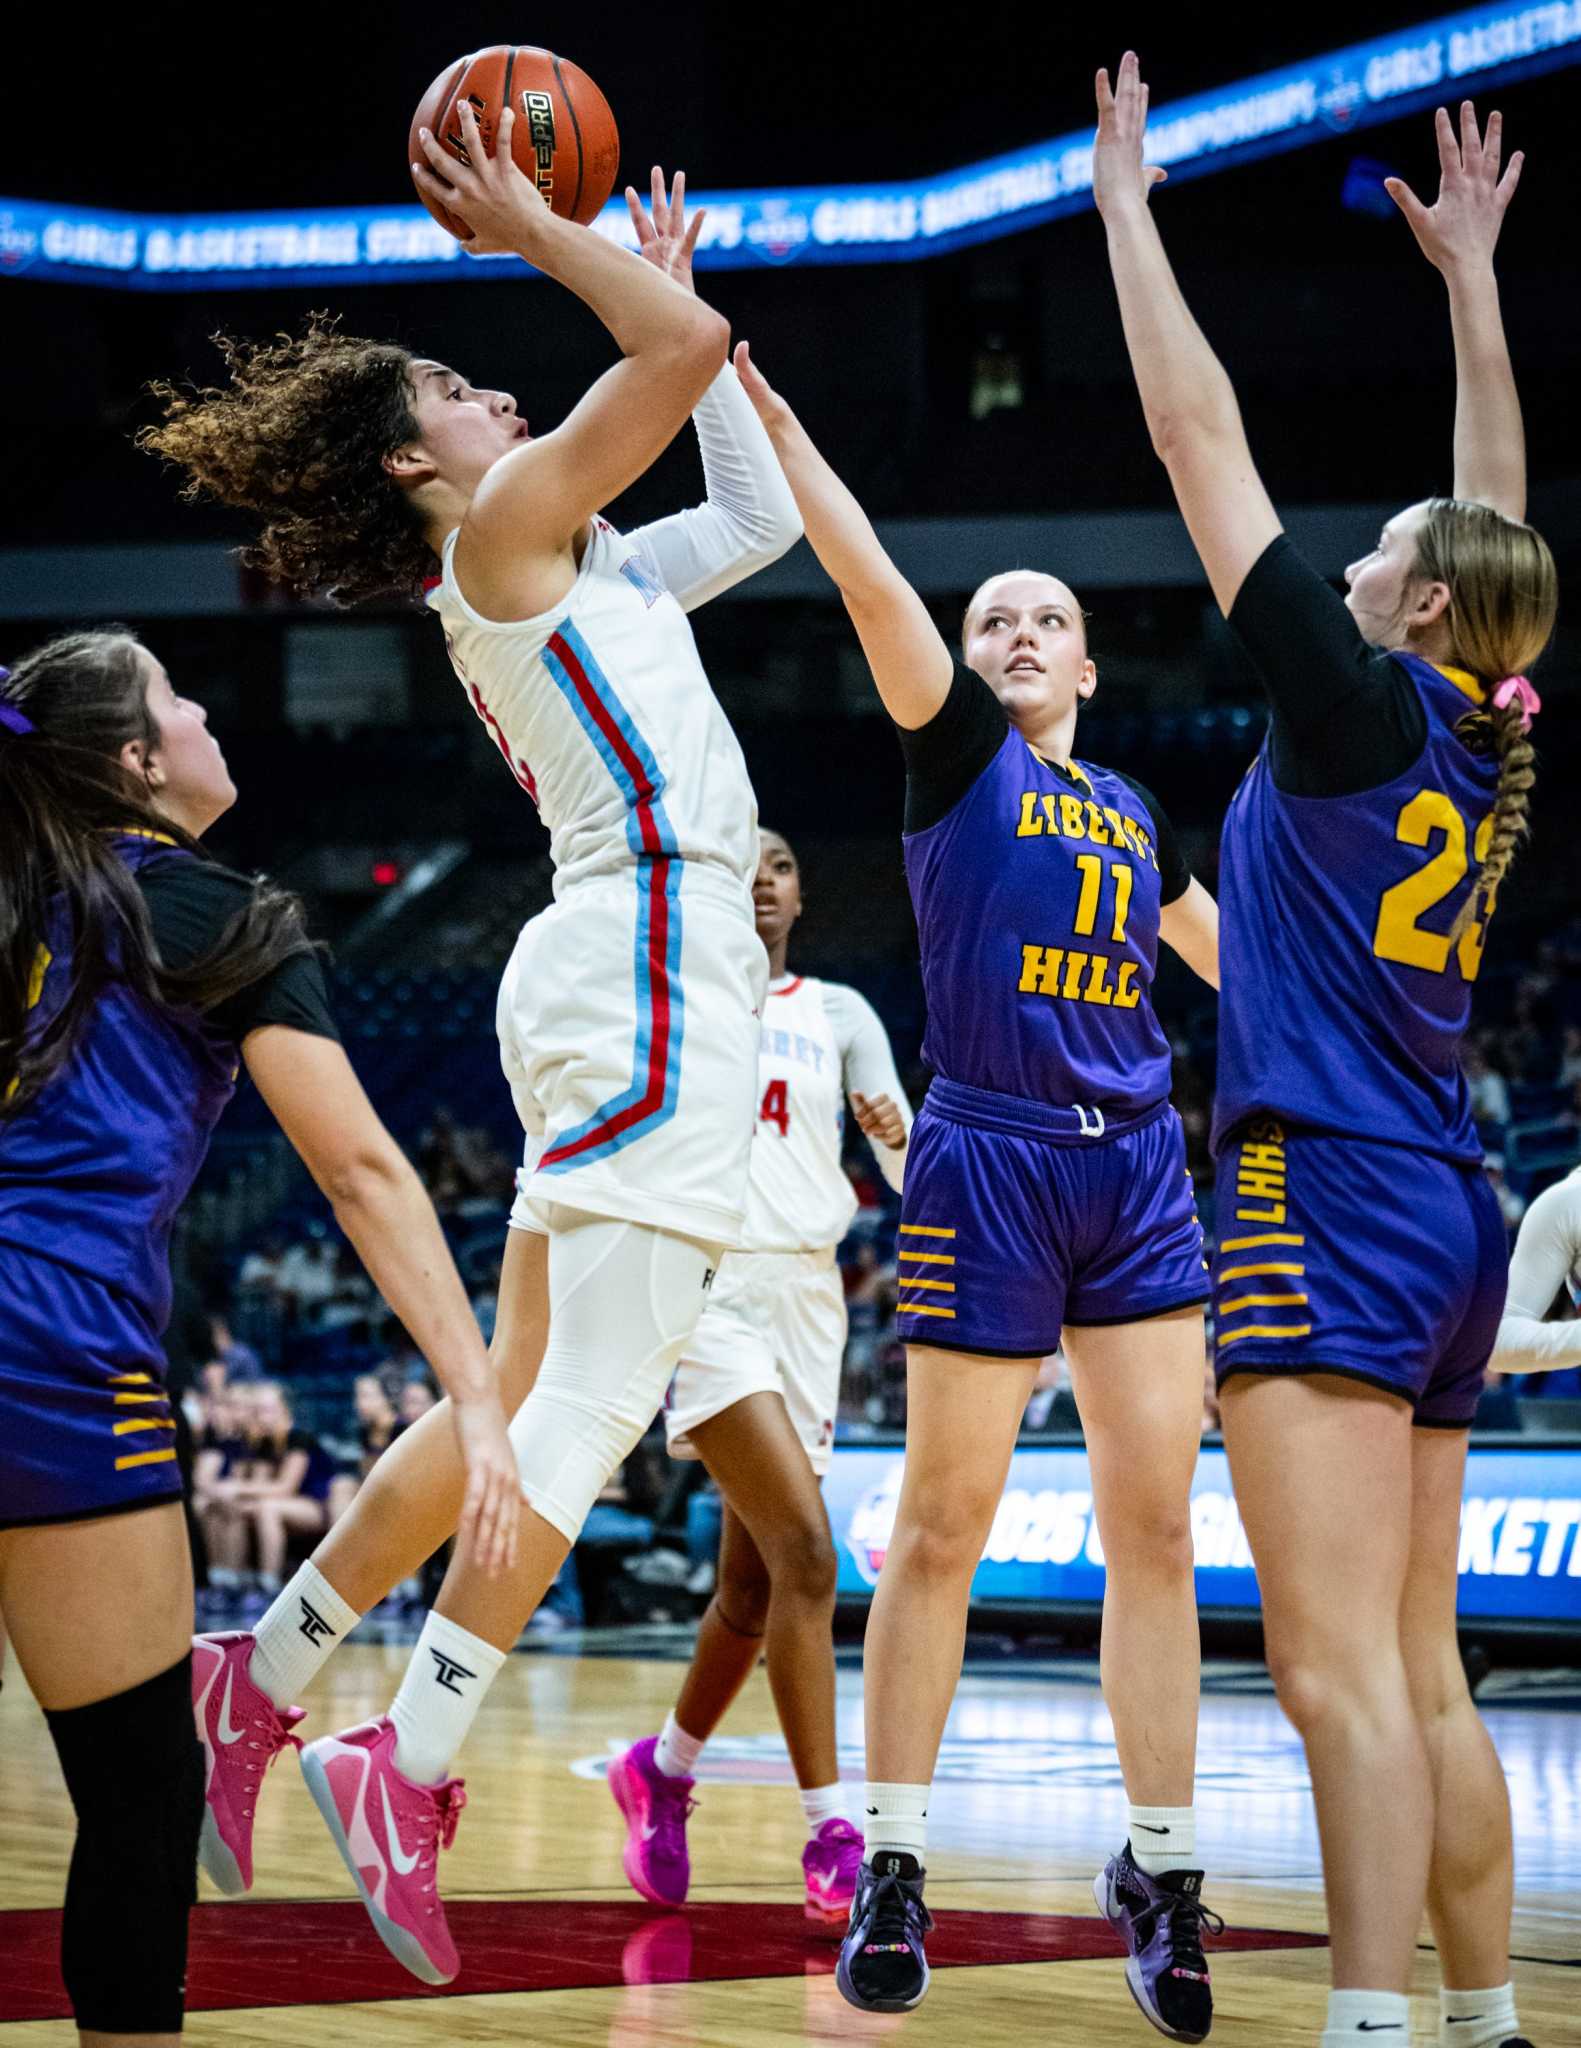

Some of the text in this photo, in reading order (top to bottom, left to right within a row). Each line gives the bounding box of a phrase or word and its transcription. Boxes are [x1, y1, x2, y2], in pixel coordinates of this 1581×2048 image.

[1073, 852, 1133, 944] 11
[1017, 943, 1141, 1009] HILL
[752, 1078, 791, 1138] 4
[979, 1489, 1093, 1566] 025
